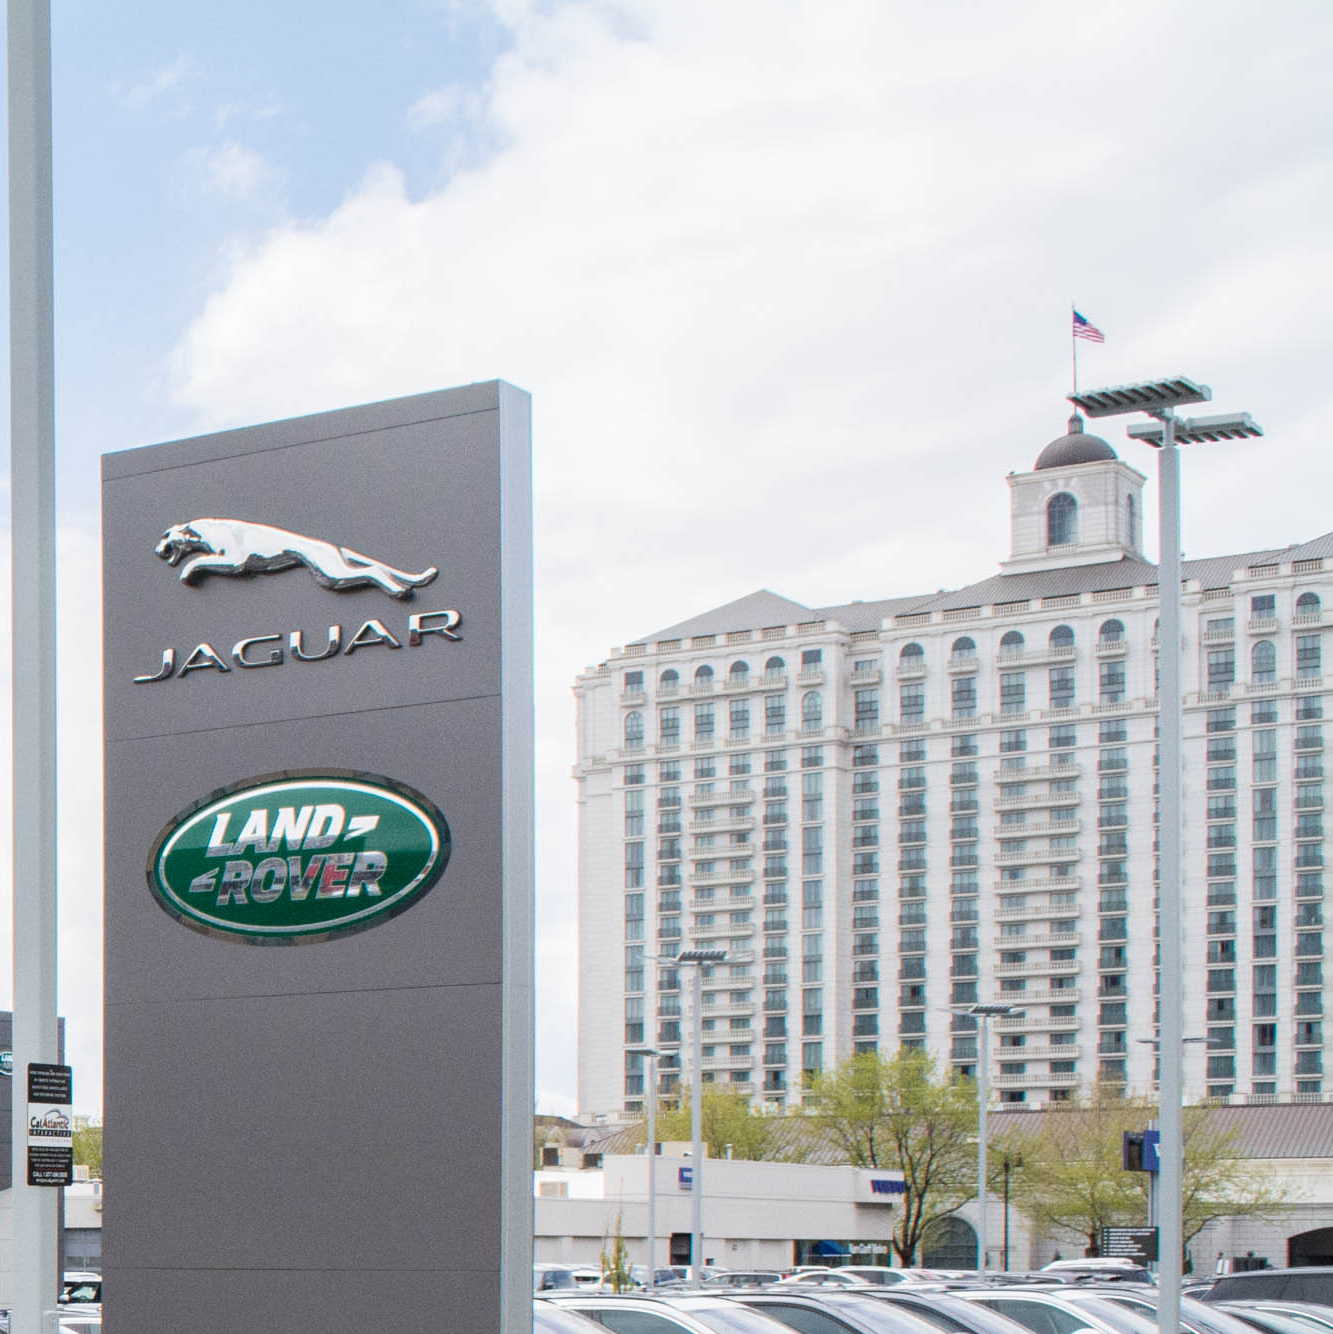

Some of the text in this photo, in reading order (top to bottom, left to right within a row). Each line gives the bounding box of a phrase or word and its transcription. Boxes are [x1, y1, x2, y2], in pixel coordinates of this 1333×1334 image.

[132, 608, 464, 684] JAGUAR
[205, 803, 346, 858] LAND
[215, 850, 388, 906] ROVER
